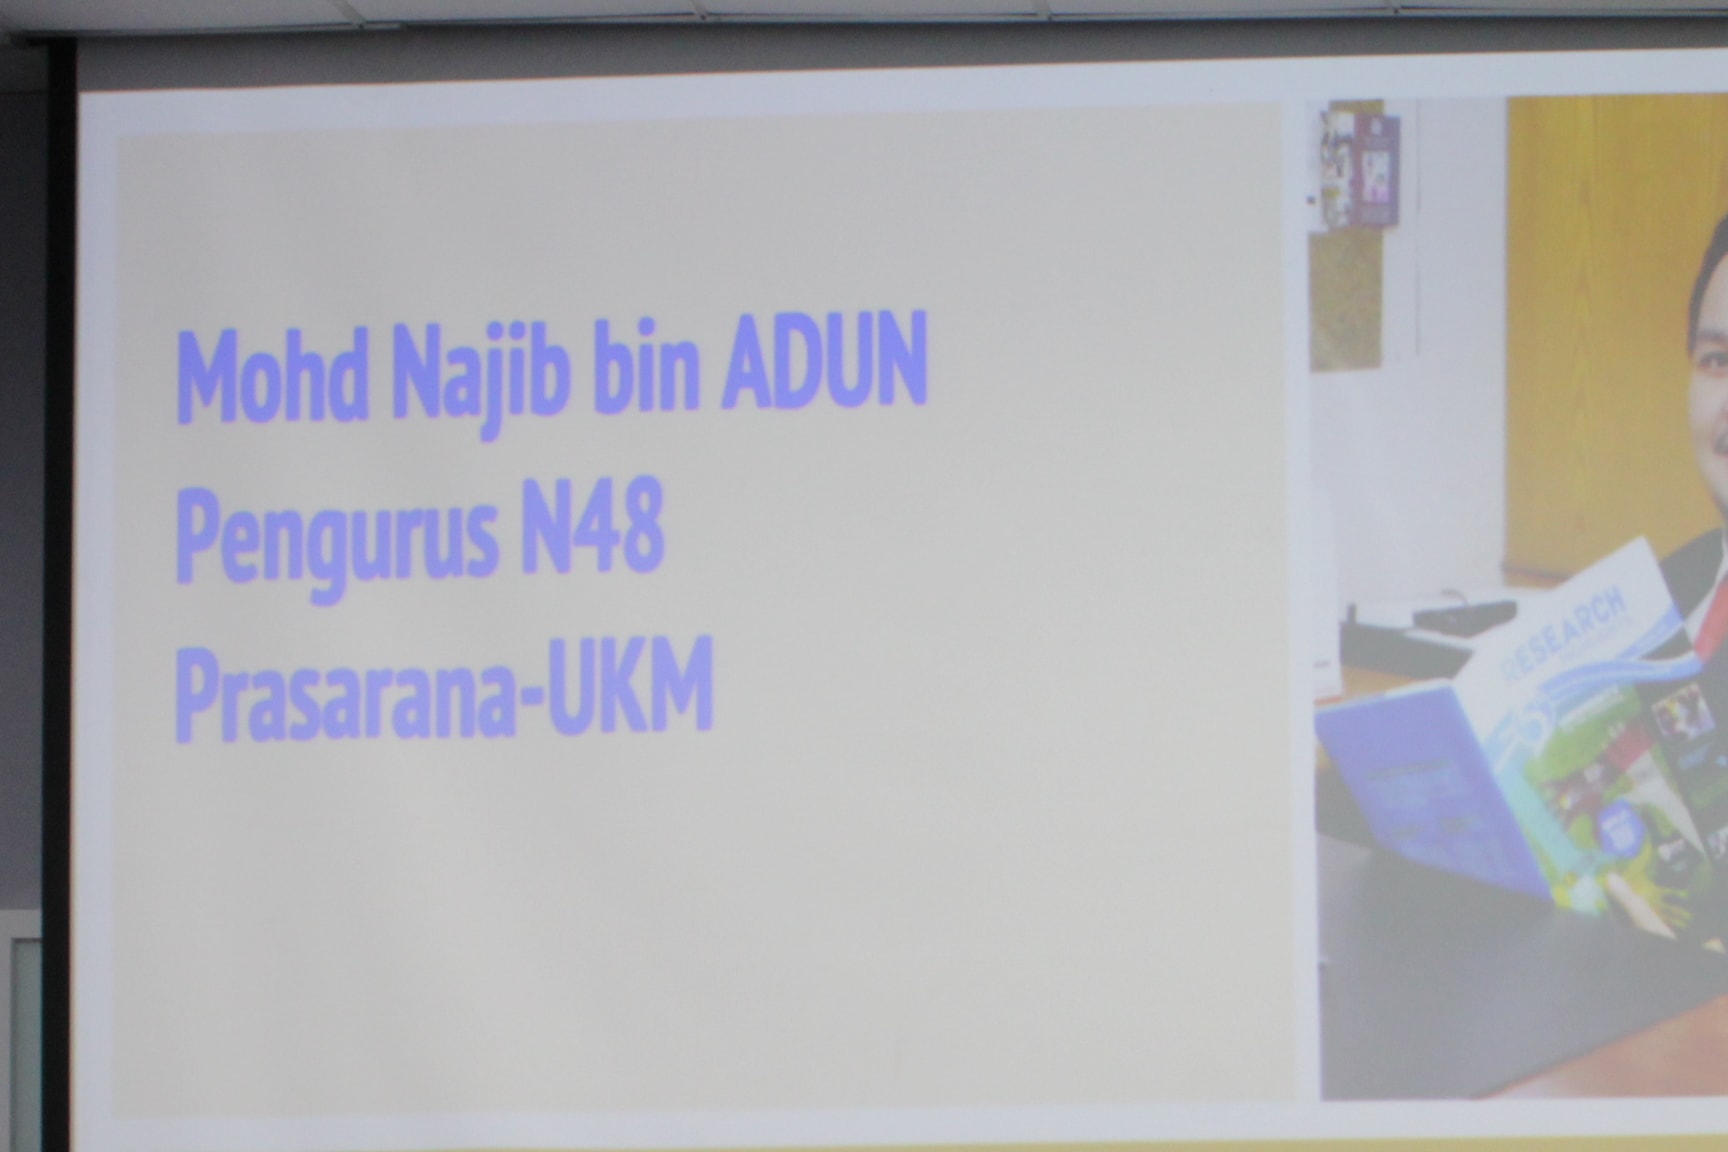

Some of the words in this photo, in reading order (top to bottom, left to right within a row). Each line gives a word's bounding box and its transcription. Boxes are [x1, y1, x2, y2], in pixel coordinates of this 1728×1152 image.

[177, 326, 369, 425] Mohd
[393, 321, 570, 443] Najib
[594, 317, 700, 414] bin
[720, 310, 927, 409] ADUN
[177, 487, 499, 606] Pengurus
[522, 475, 665, 574] N48
[176, 634, 713, 743] Prasarana-UKM
[1499, 583, 1628, 681] RESEARCH
